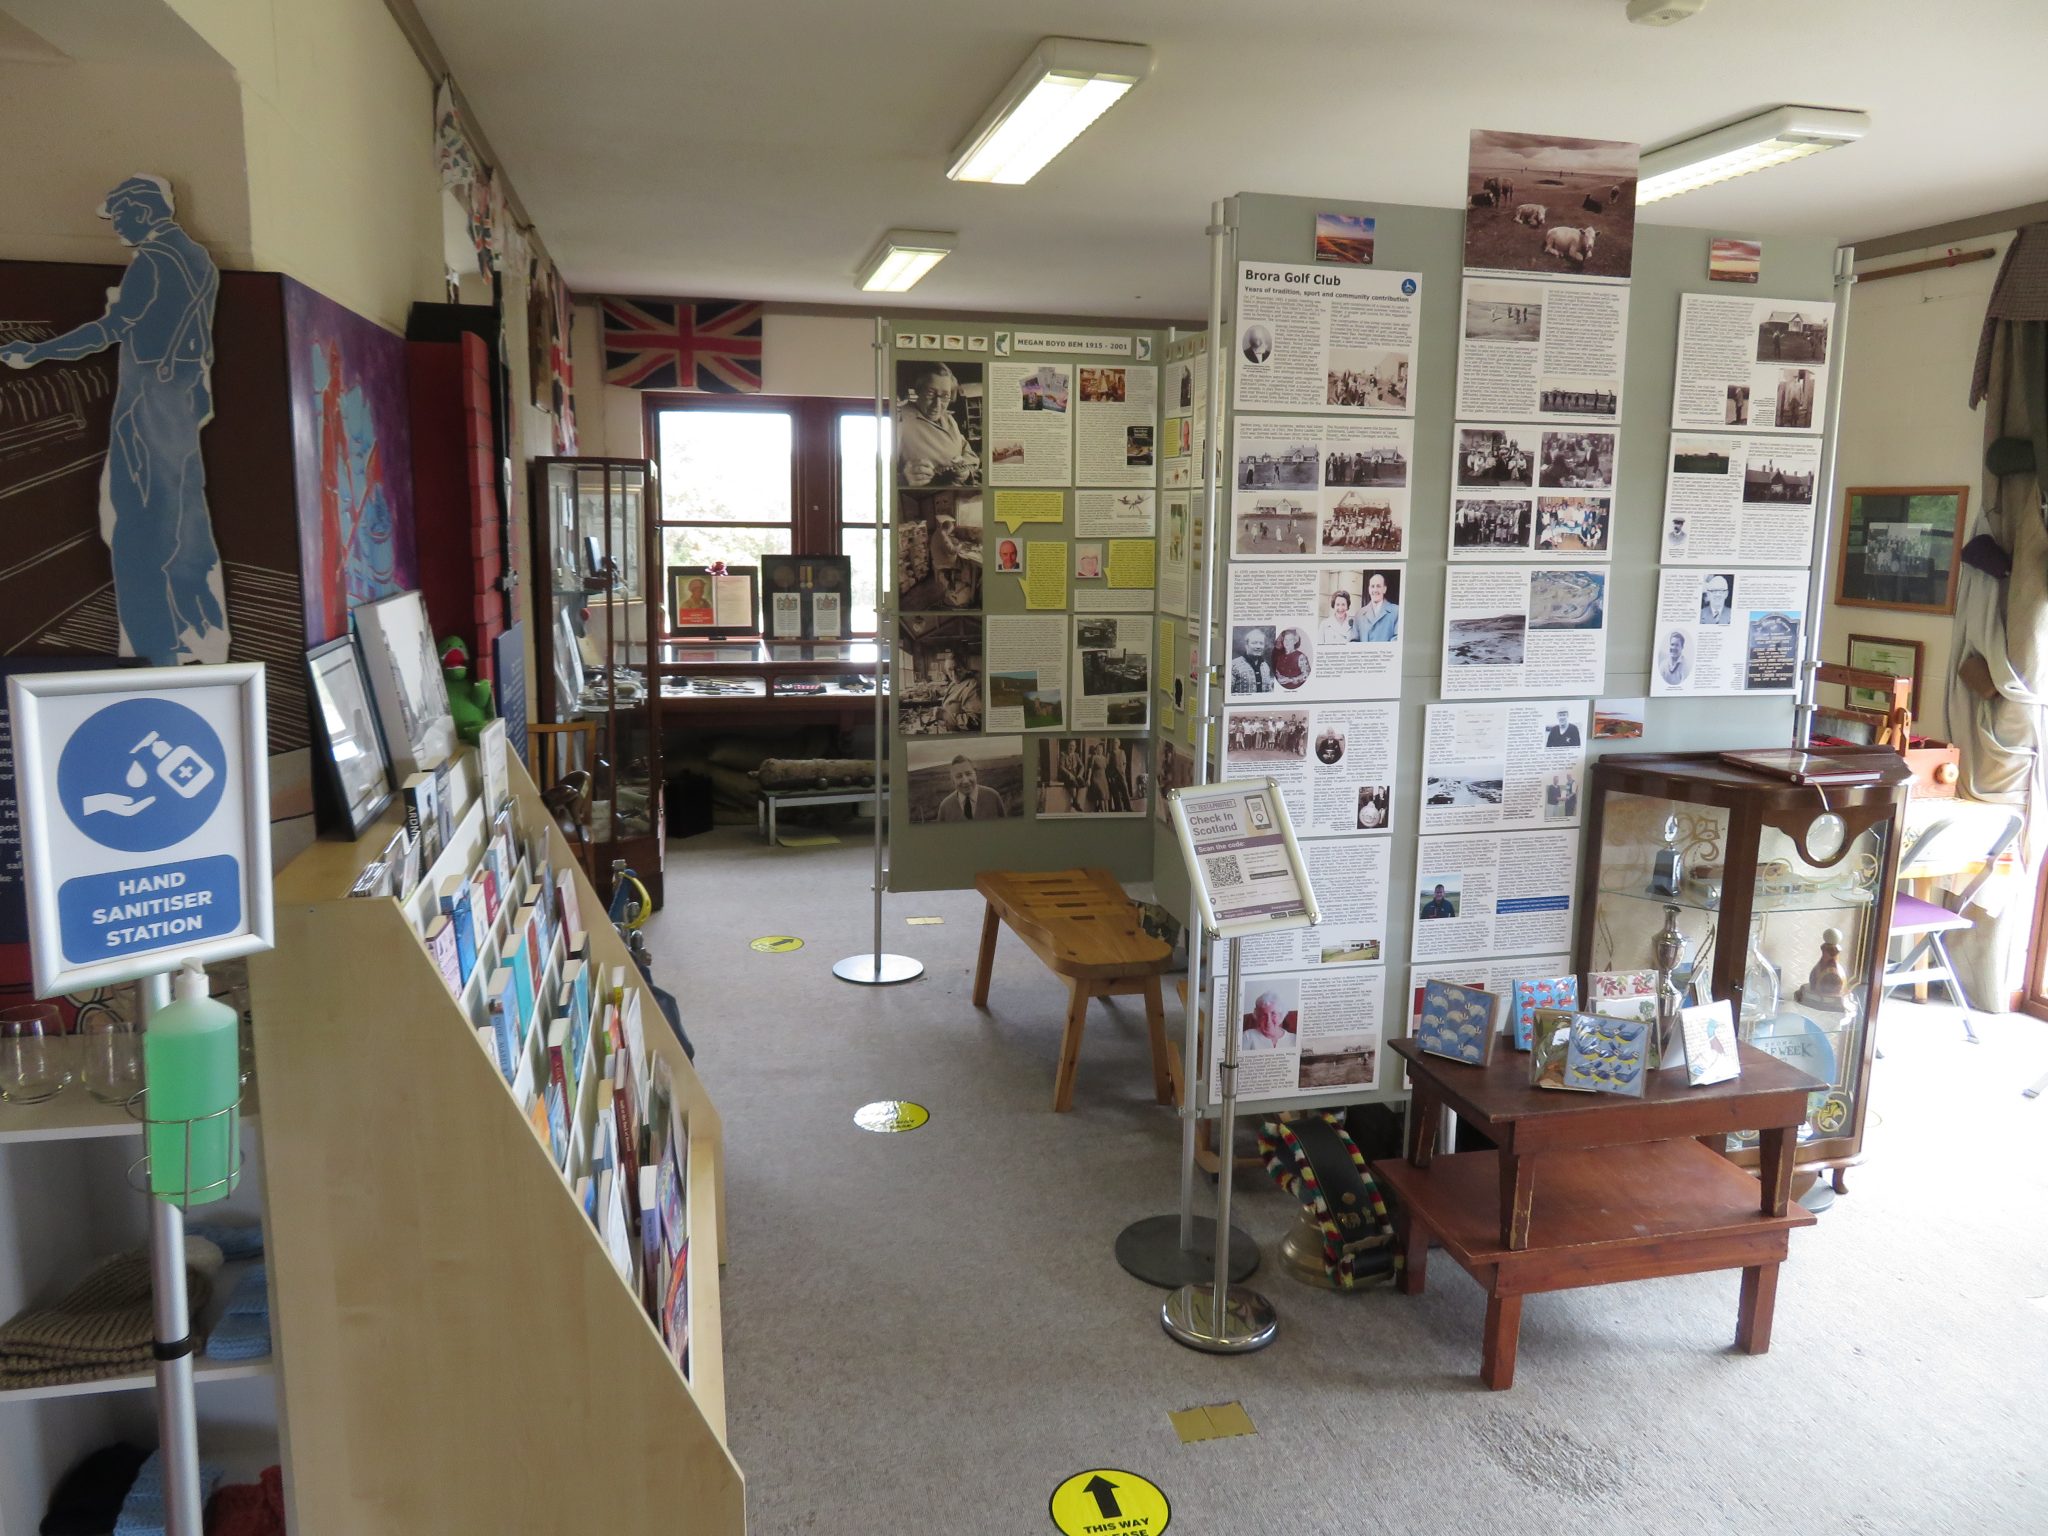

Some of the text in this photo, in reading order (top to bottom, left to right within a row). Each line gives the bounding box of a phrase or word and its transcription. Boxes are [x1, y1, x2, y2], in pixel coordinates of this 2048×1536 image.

[1245, 269, 1341, 286] Brora Golf Club
[1272, 288, 1302, 296] tradition,
[1336, 293, 1370, 301] community
[1190, 812, 1234, 826] Check In
[1192, 822, 1238, 836] Scotland
[1198, 841, 1246, 854] Scan the code:
[119, 871, 186, 897] HAND
[92, 890, 212, 926] SANITISER
[106, 914, 203, 947] STATION
[1082, 1517, 1150, 1534] THIS WAY
